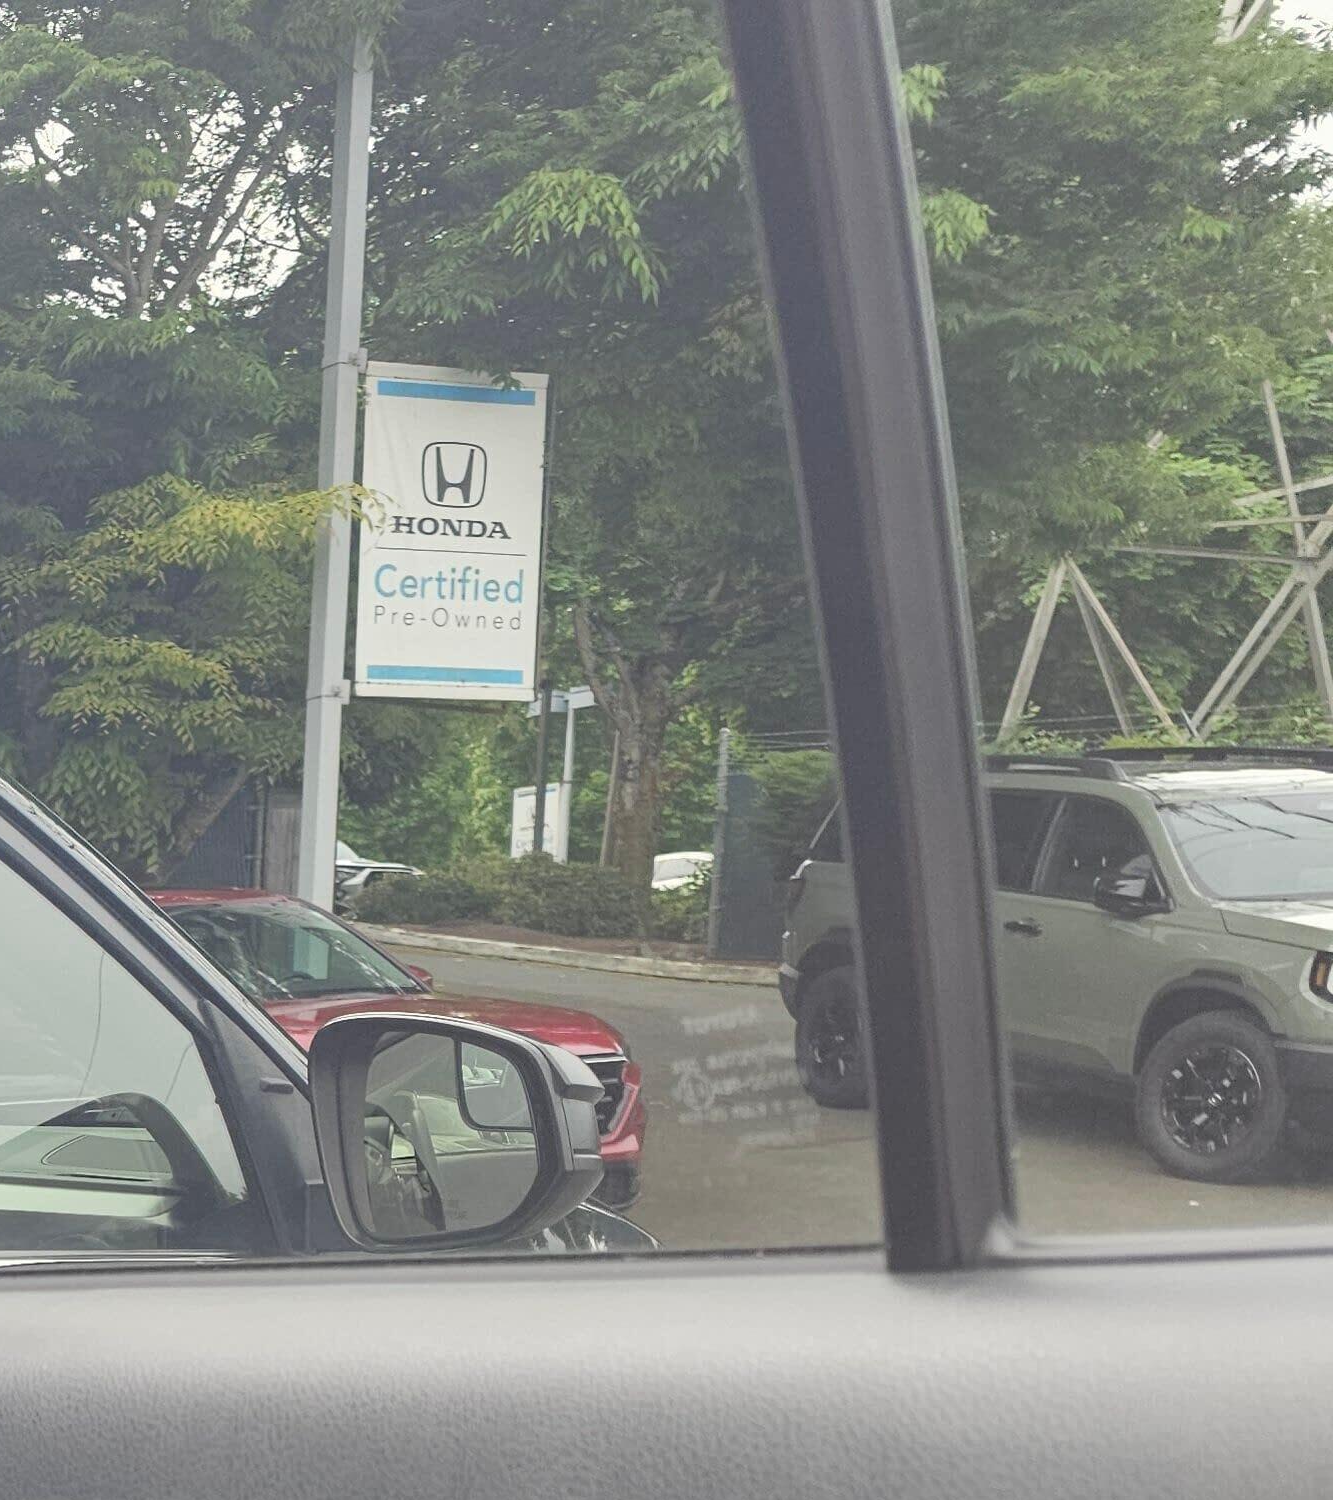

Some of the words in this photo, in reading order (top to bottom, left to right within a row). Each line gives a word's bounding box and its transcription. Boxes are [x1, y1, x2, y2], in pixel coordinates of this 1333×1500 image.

[391, 515, 512, 540] HONDA
[374, 563, 525, 604] Certified
[373, 605, 523, 631] Pre-Owned
